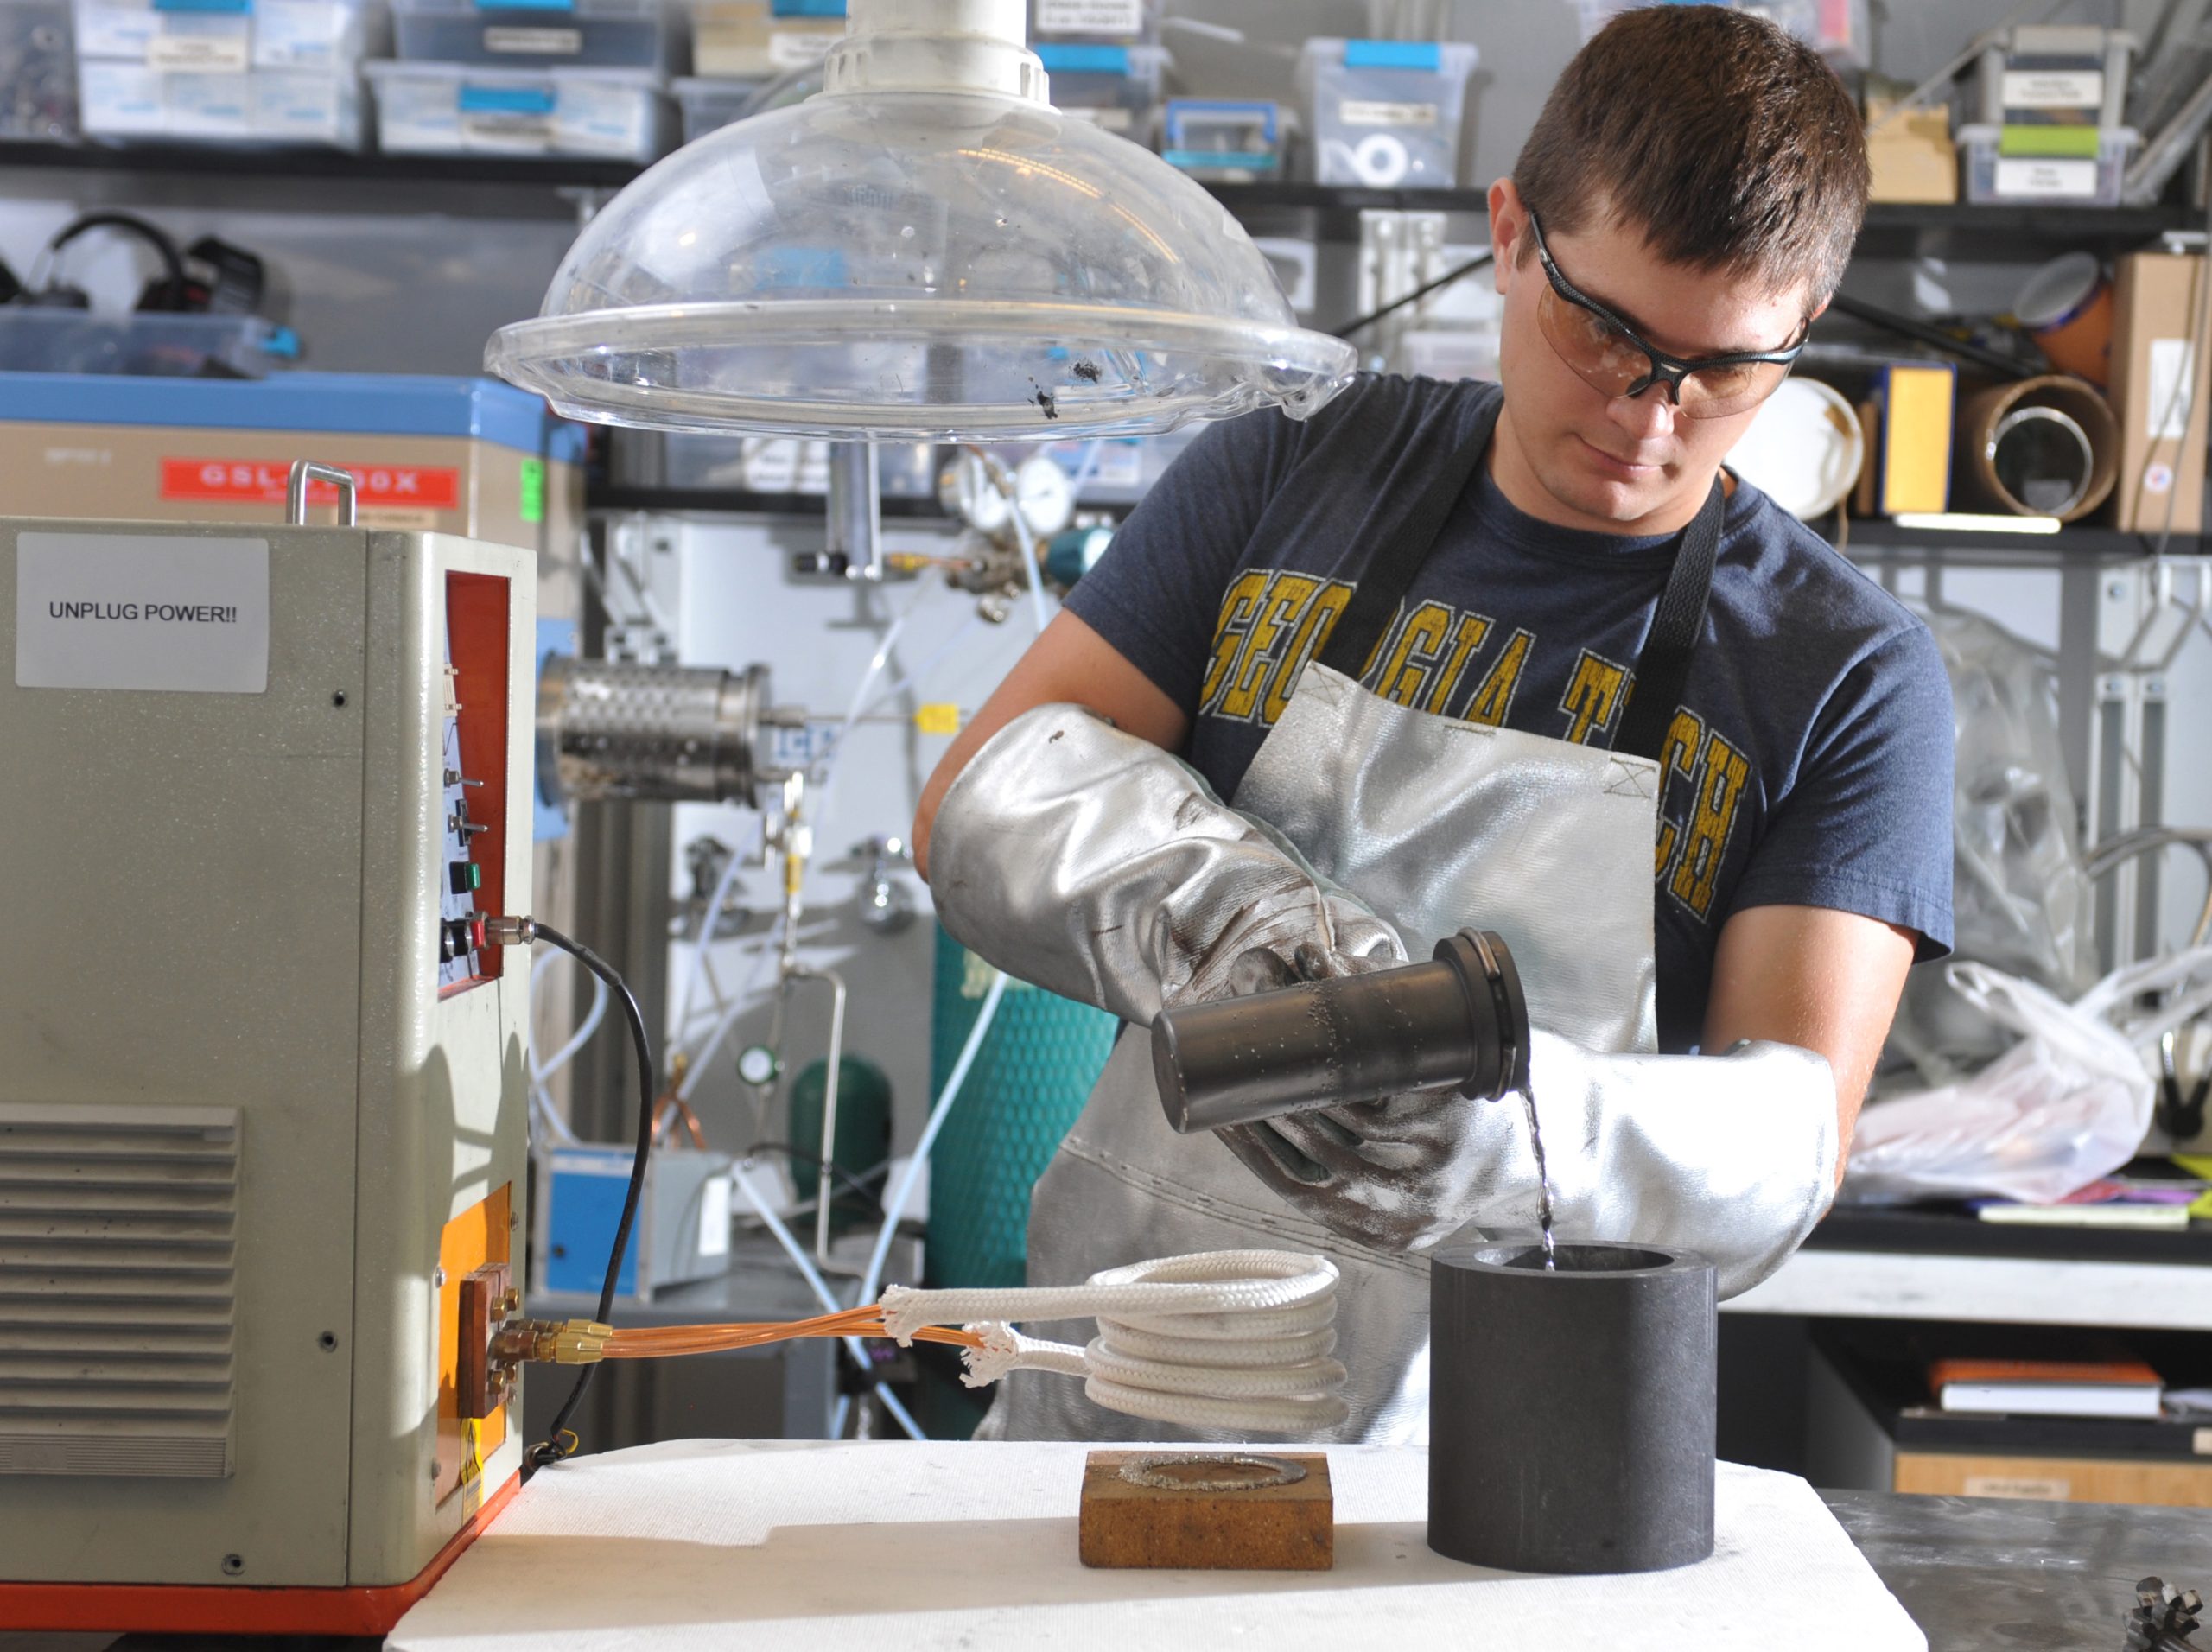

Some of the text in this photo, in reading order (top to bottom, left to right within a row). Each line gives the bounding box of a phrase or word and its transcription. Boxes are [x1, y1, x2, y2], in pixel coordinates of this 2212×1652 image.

[49, 601, 237, 623] UNPLUG POWER!!
[1198, 567, 1753, 925] GEOGIA TCH
